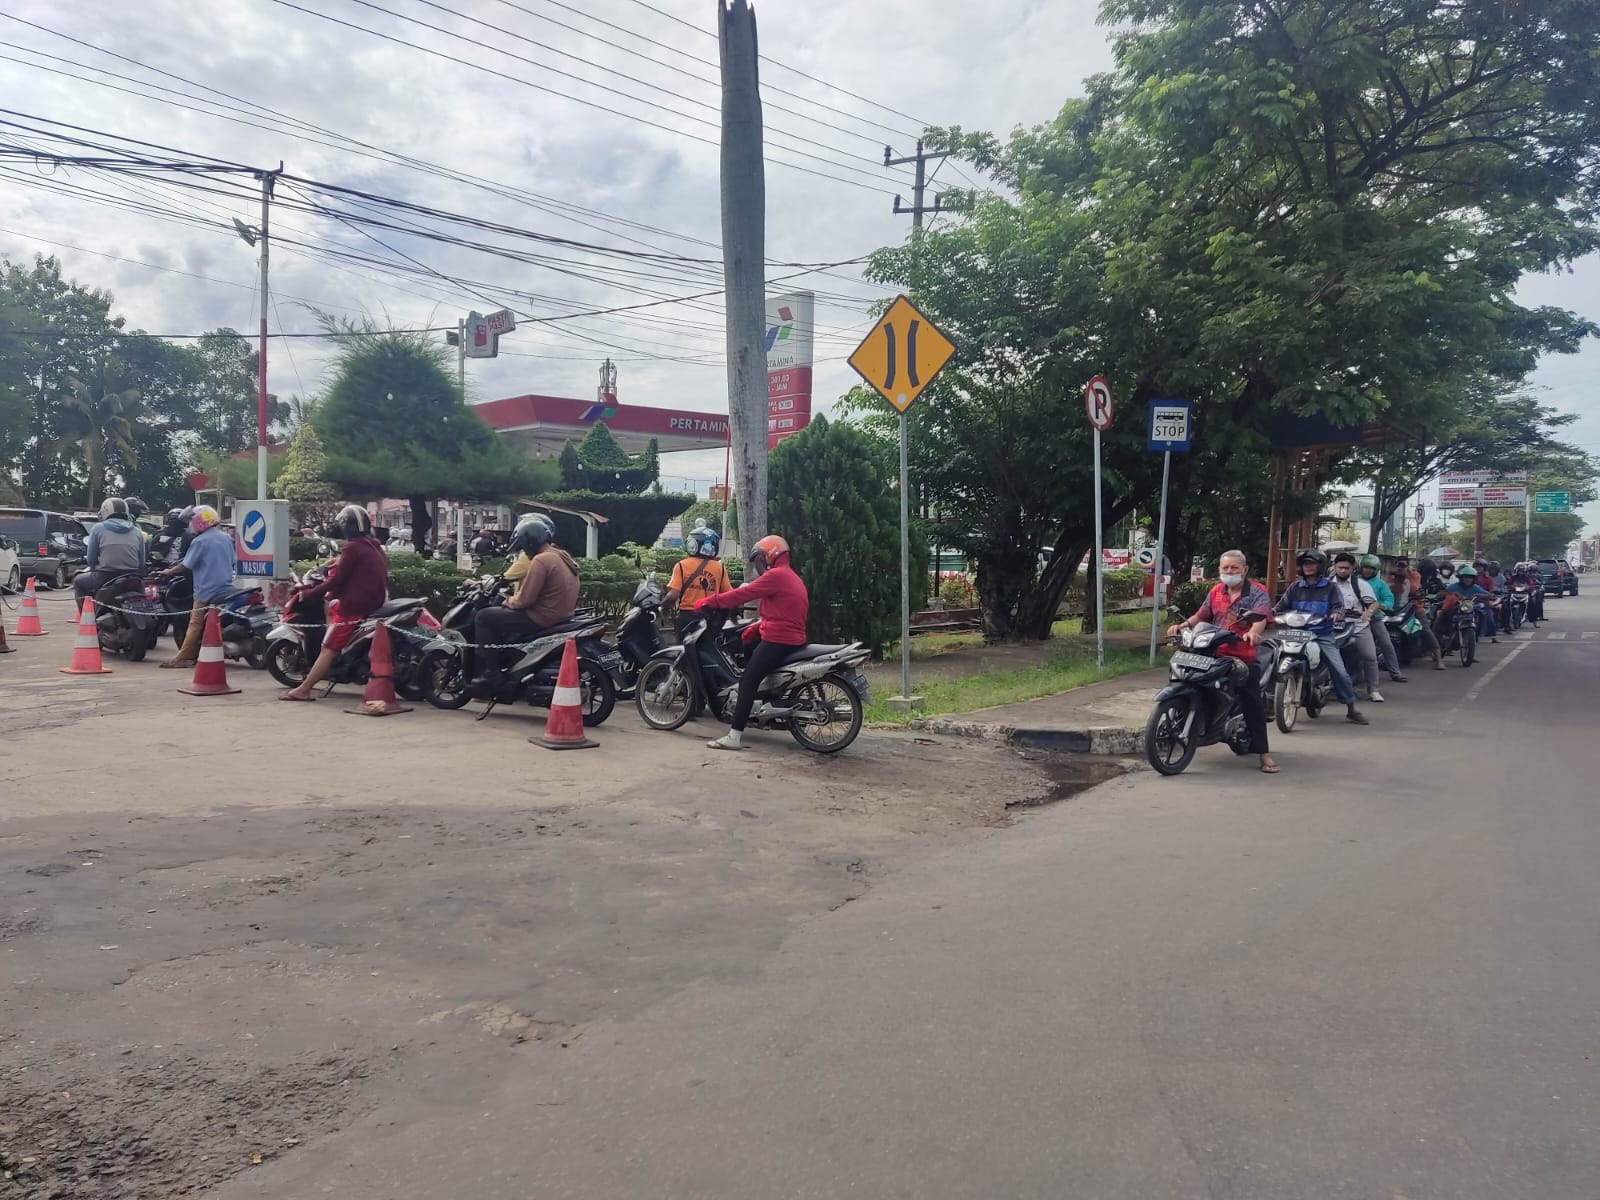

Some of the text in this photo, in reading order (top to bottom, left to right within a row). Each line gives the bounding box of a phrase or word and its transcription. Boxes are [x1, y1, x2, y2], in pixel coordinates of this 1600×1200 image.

[670, 417, 730, 433] PERTAMIN
[1155, 425, 1185, 437] STOP
[242, 561, 267, 574] MASUK
